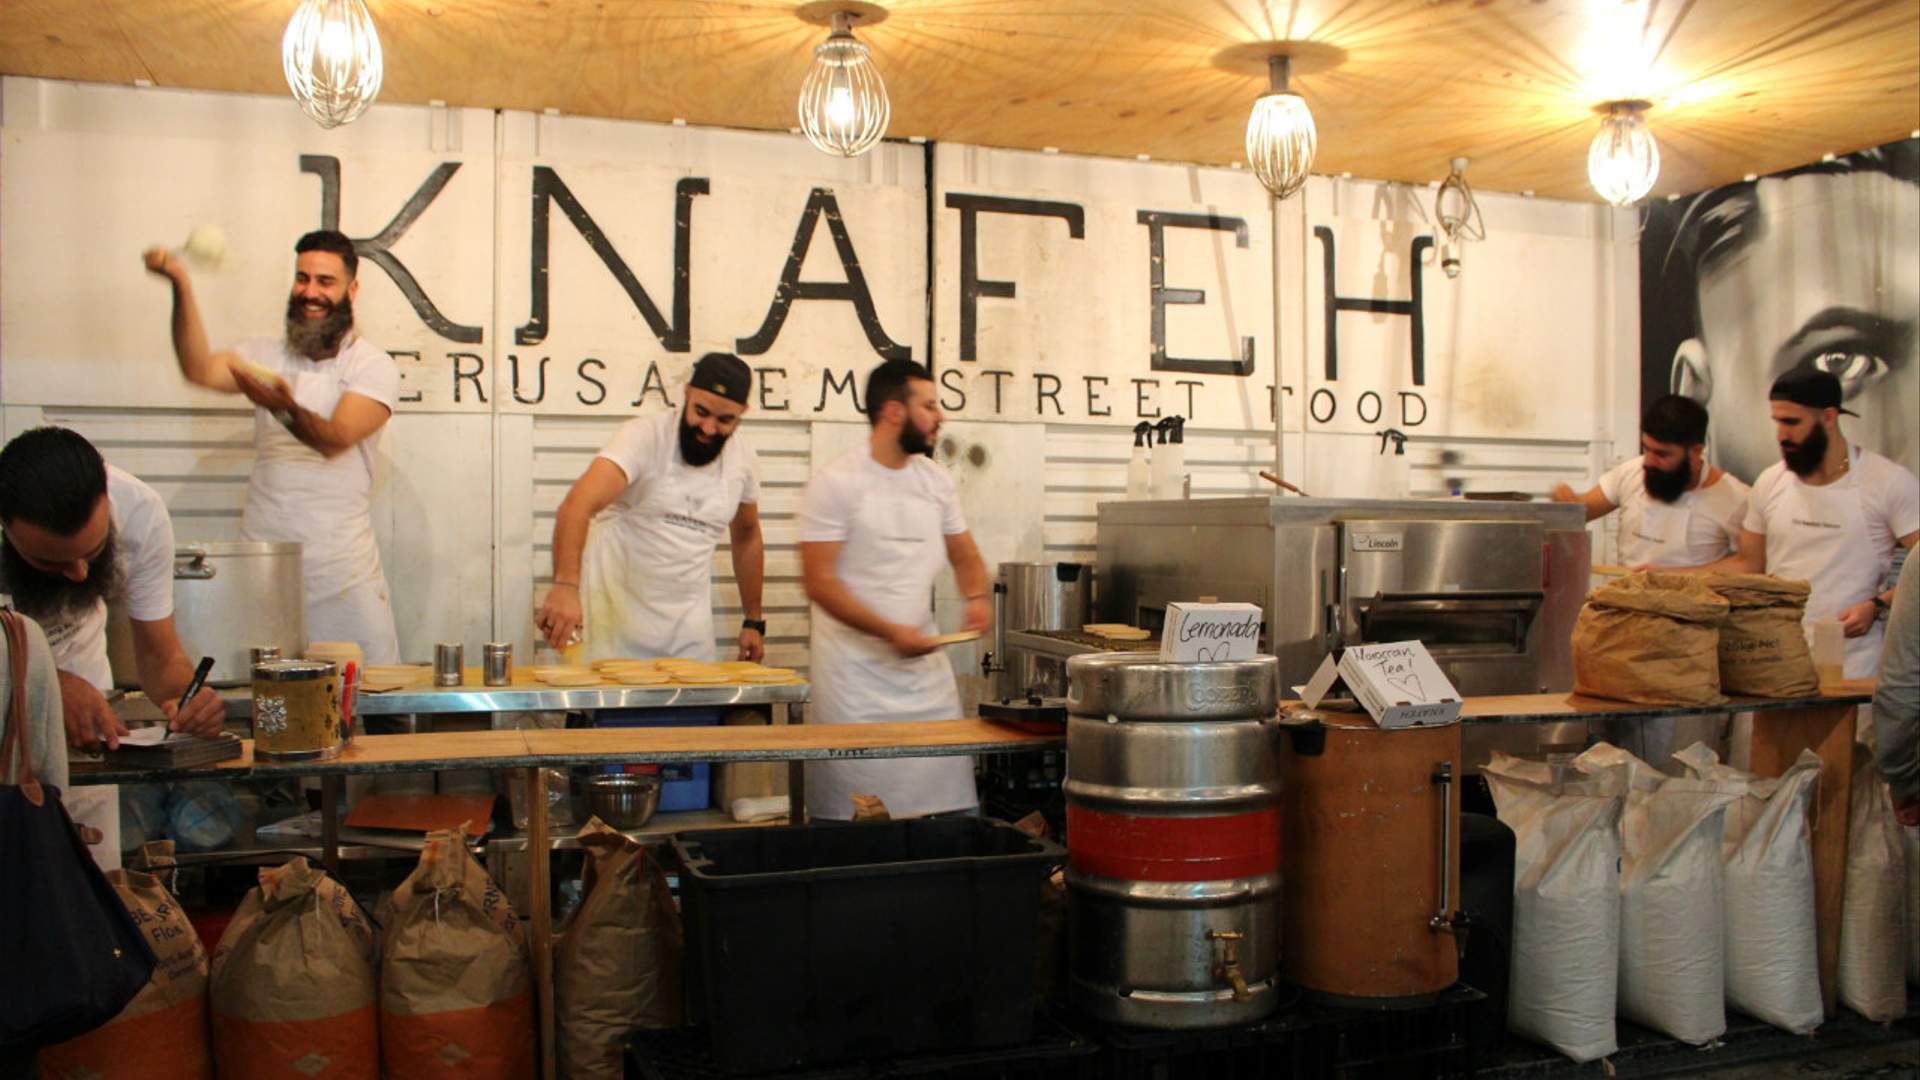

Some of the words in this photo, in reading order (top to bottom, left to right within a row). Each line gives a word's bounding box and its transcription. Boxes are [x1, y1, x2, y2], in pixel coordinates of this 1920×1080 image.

[299, 154, 1434, 386] KNAFEH
[385, 350, 869, 414] ERUSAEM
[939, 368, 1205, 420] STREET
[1265, 384, 1428, 427] FOOD
[1368, 536, 1399, 548] Lincoln
